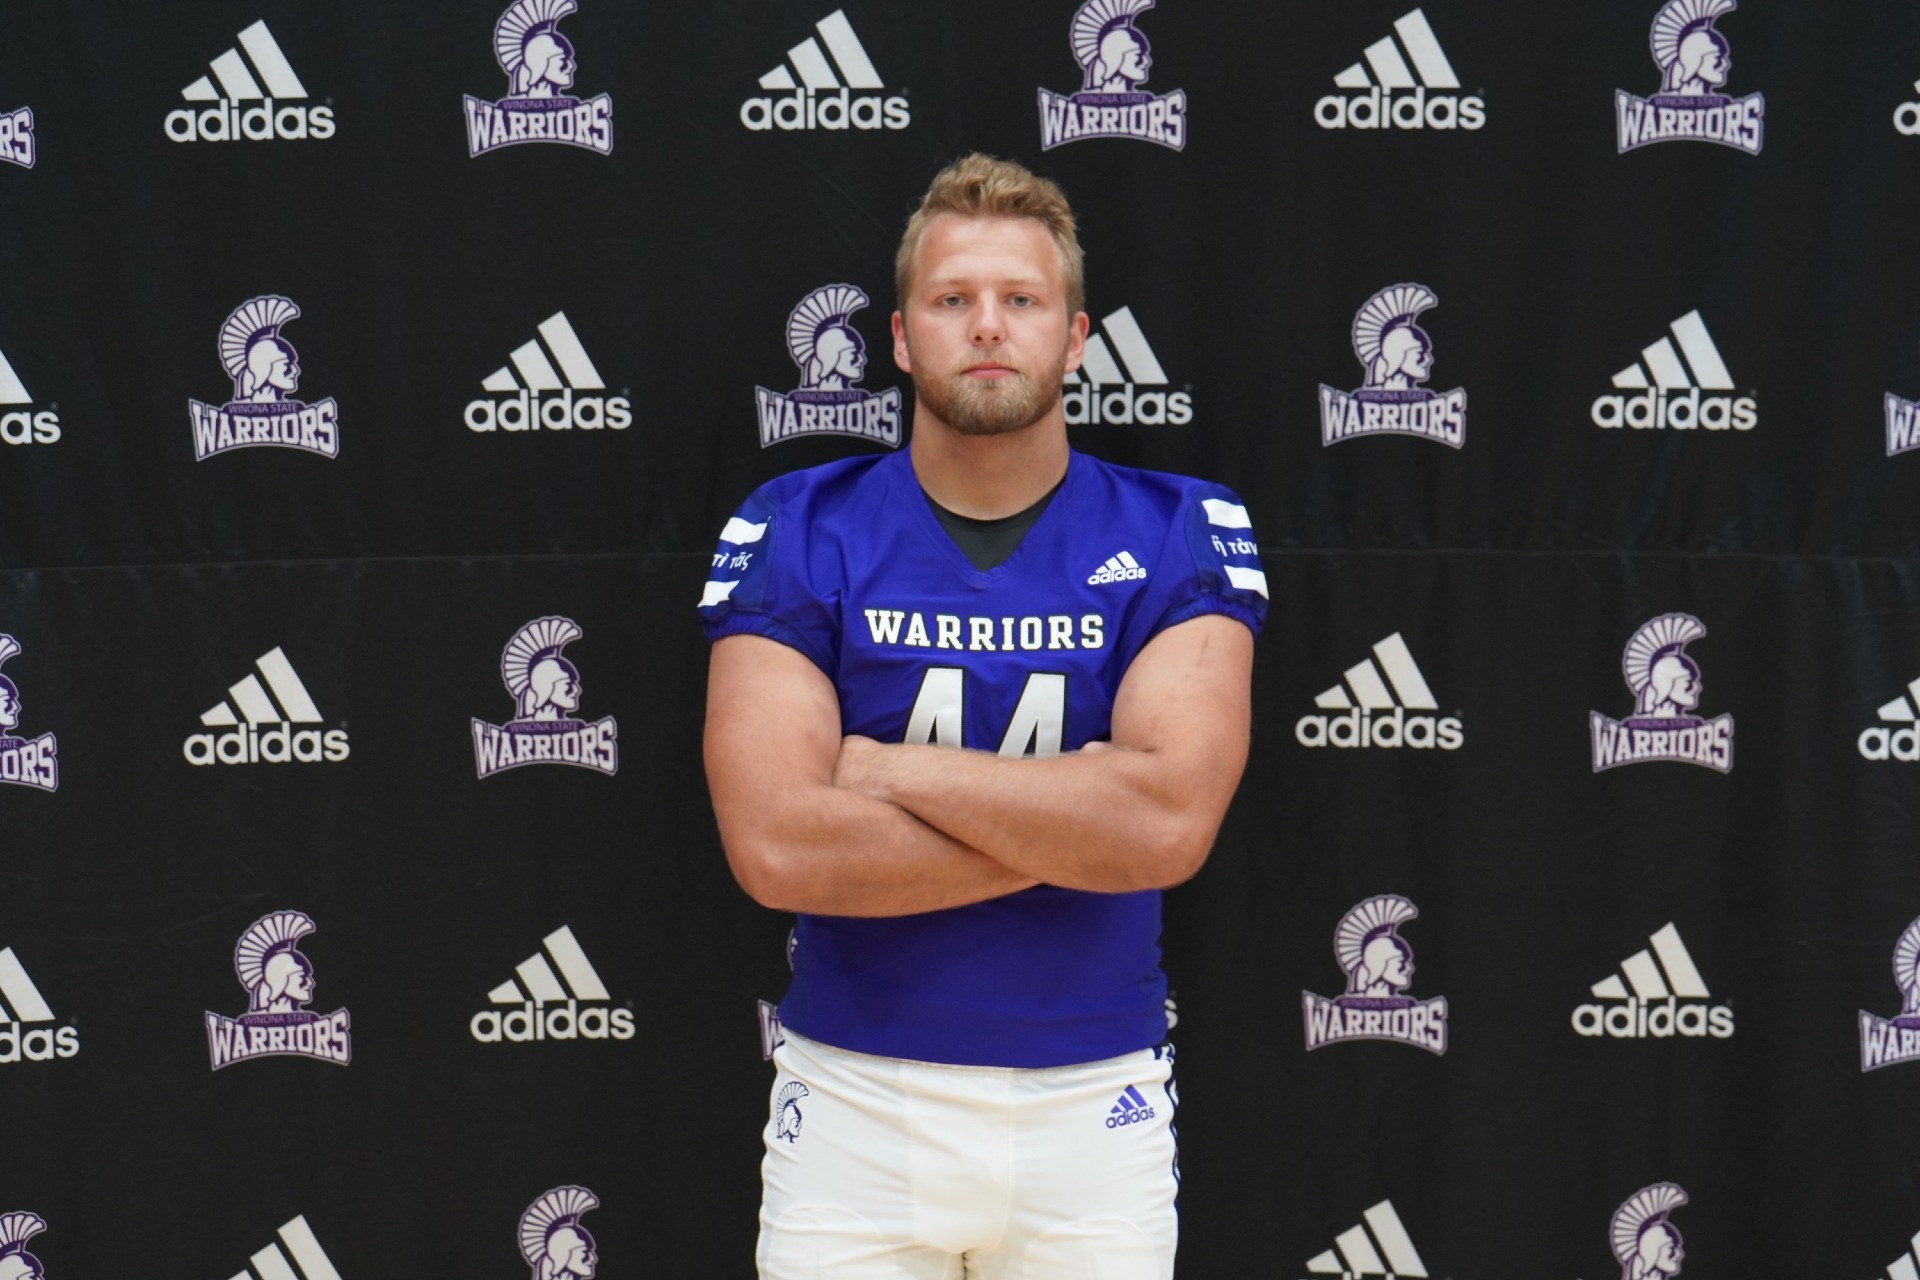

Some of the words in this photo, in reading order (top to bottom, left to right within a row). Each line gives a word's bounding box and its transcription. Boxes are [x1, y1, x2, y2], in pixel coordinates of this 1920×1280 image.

[165, 98, 335, 142] adidas
[467, 98, 609, 152] WARRIORS
[503, 100, 545, 110] WINONA
[547, 99, 574, 109] STATE
[741, 87, 910, 130] adidas
[1042, 94, 1182, 146] WARRIORS
[1315, 86, 1485, 129] adidas
[1620, 96, 1760, 150] WARRIORS
[228, 404, 269, 415] WINONA
[271, 403, 298, 413] STATE
[465, 388, 632, 432] adidas
[759, 391, 899, 442] WARRIORS
[1062, 382, 1192, 424] didas
[1323, 390, 1463, 444] WARRIORS
[1592, 387, 1757, 430] adidas
[192, 401, 335, 456] WARRIORS
[1087, 567, 1147, 585] adidas
[864, 609, 1104, 651] WARRIORS
[184, 721, 349, 765] adidas
[475, 720, 614, 774] WARRIORS
[511, 723, 550, 733] WINONA
[552, 722, 578, 732] STATE
[1296, 707, 1463, 749] adidas
[1594, 717, 1730, 768] WARRIORS
[244, 1015, 284, 1025] WINONA
[287, 1013, 312, 1024] STATE
[471, 1000, 635, 1042] adidas
[1306, 997, 1443, 1050] WARRIORS
[1572, 996, 1734, 1037] adidas
[0, 1021, 79, 1063] das
[209, 1013, 348, 1065] WARRIORS
[1105, 1106, 1155, 1129] adidas
